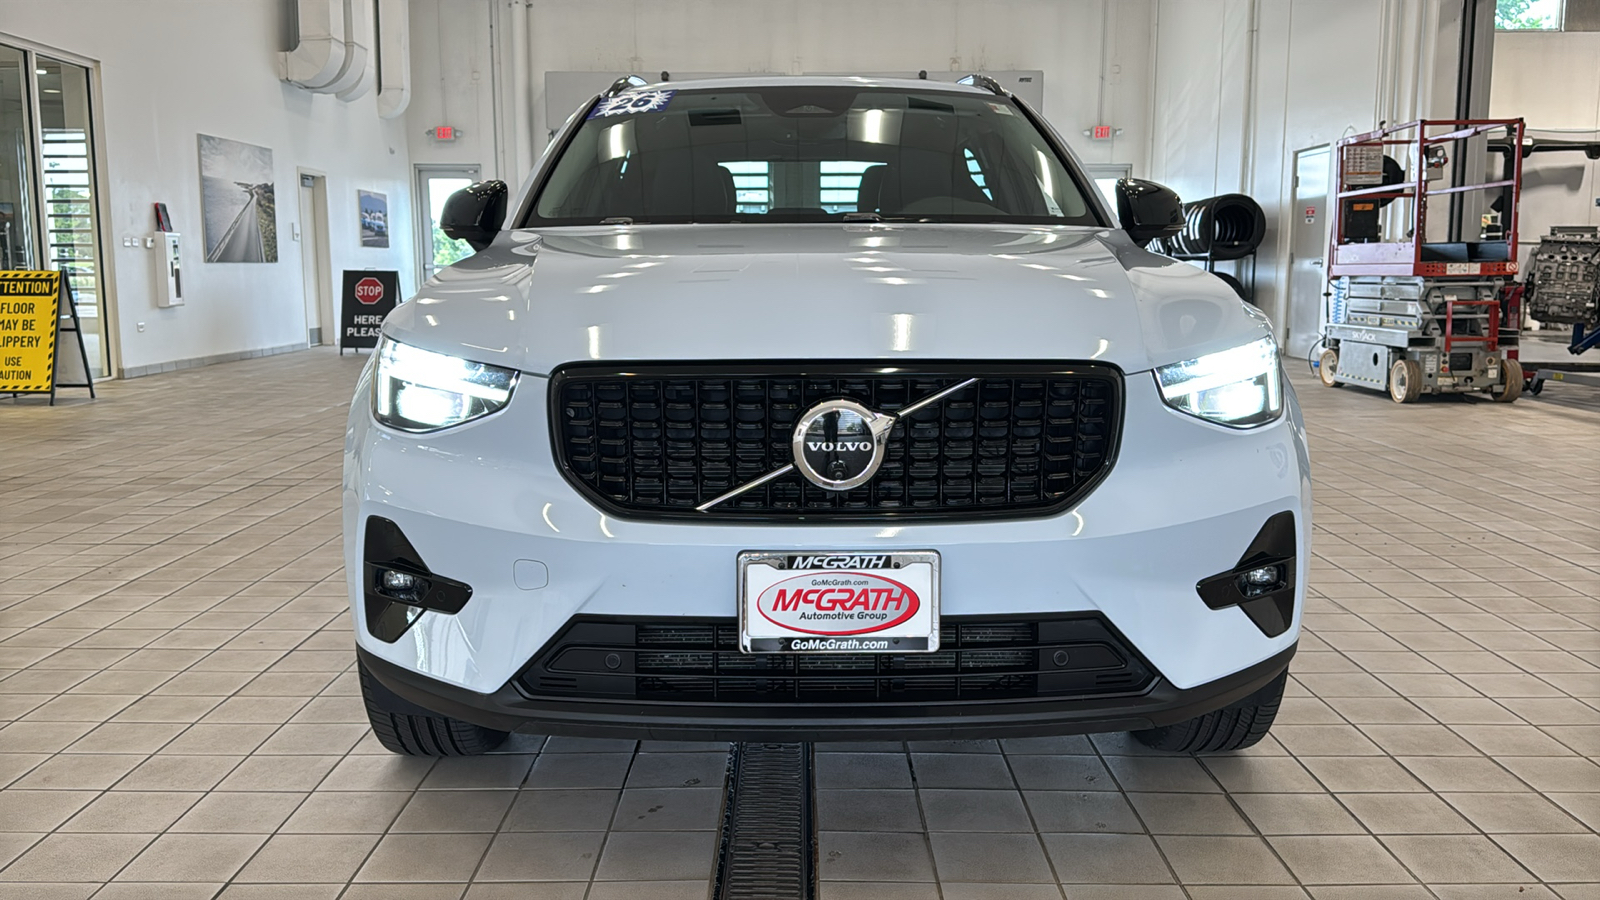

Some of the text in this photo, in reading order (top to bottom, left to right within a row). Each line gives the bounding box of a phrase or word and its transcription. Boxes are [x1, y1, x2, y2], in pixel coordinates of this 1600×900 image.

[608, 95, 656, 111] 26
[0, 281, 50, 294] TENTION
[357, 286, 382, 296] STOP
[1, 302, 35, 314] FLOOR
[22, 319, 36, 331] BE
[354, 315, 383, 325] HERE
[346, 327, 381, 337] PLEAS
[0, 335, 41, 348] IPPERY
[4, 356, 22, 367] USE
[0, 370, 32, 380] AUTION
[806, 441, 872, 452] VOLVO
[811, 579, 869, 587] GoMcGrath.com
[799, 611, 888, 621] Automotive Group
[790, 638, 889, 651] GoMcGrath.com
